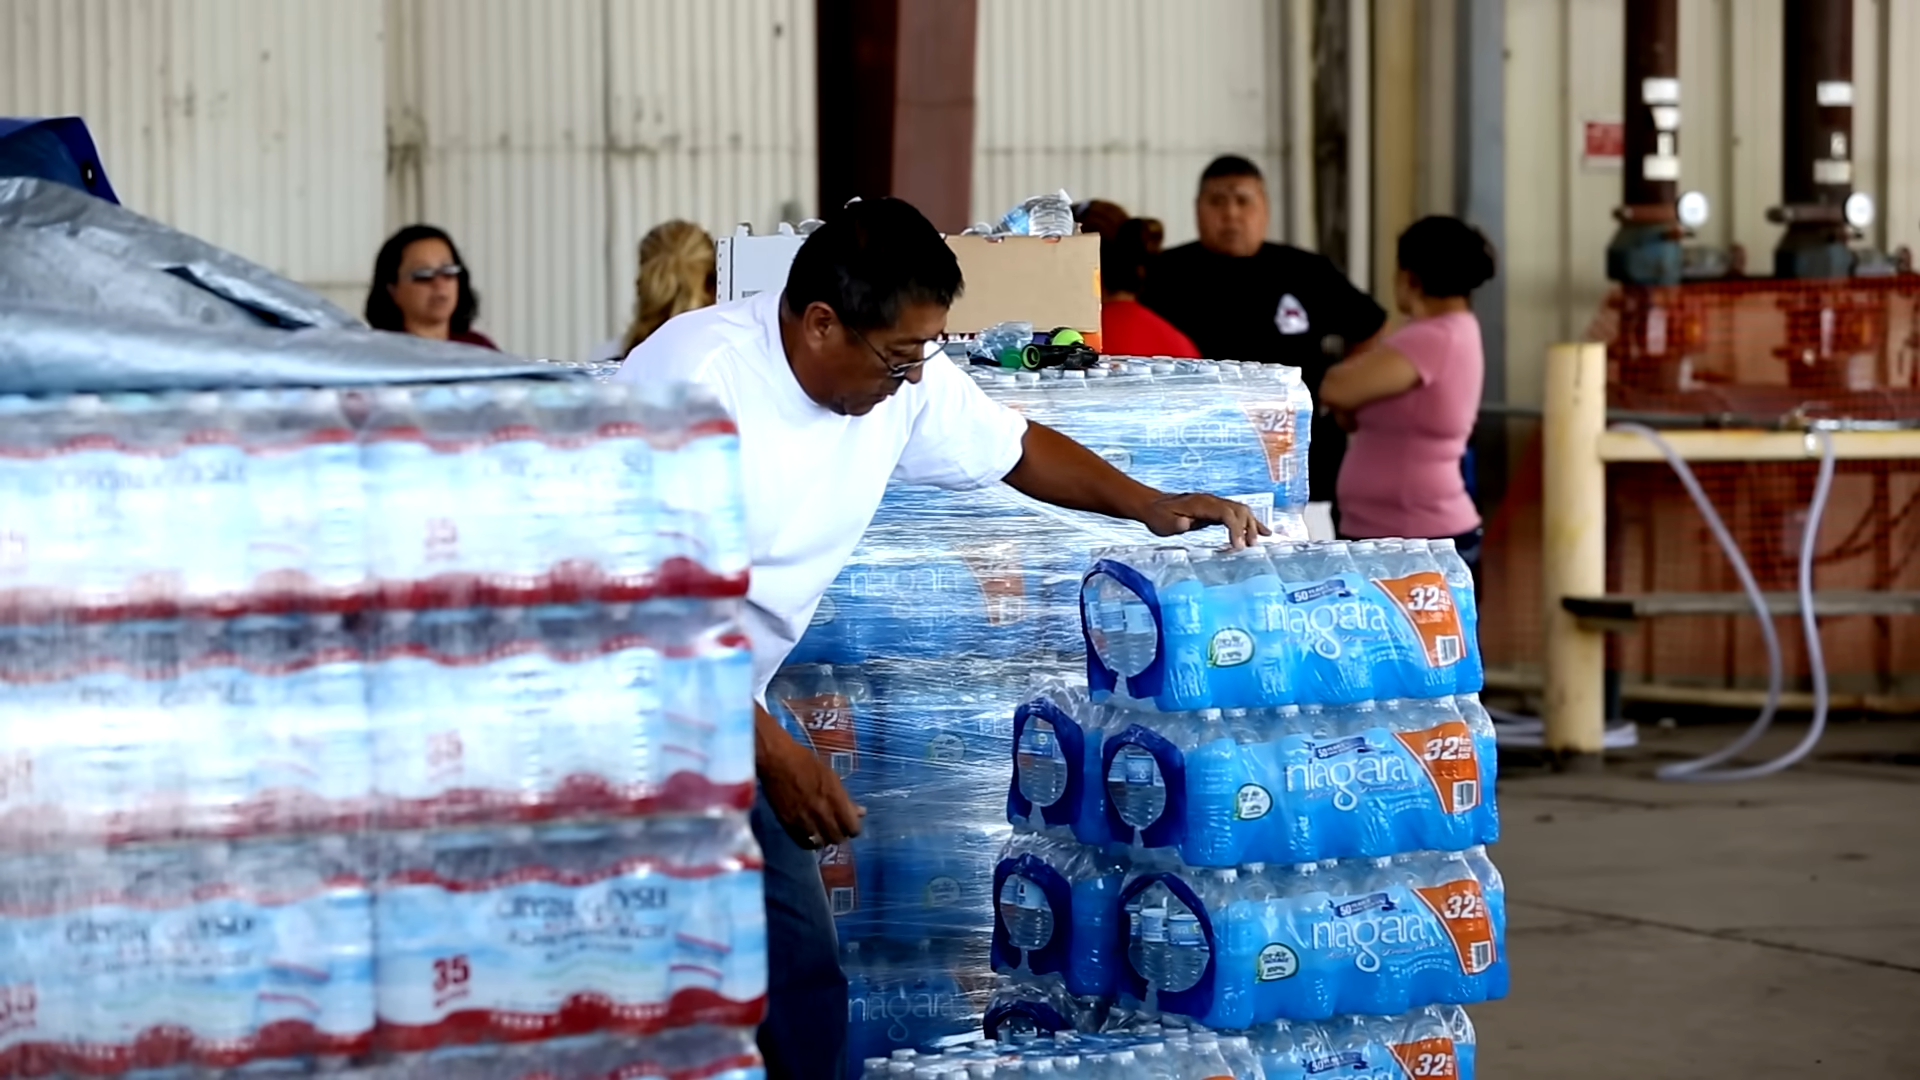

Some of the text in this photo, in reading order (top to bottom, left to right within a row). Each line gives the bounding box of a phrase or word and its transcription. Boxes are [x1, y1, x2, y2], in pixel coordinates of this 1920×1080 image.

[1259, 410, 1287, 432] 32
[1294, 591, 1308, 602] 50
[1408, 587, 1440, 610] 32
[1266, 601, 1388, 659] niagara
[808, 708, 838, 730] 32
[1424, 736, 1458, 761] 32
[1286, 755, 1408, 811] niagara
[817, 845, 841, 864] 2
[1340, 904, 1351, 916] 50
[1444, 895, 1475, 919] 32
[1314, 913, 1427, 972] niagara
[432, 955, 469, 991] 35
[1415, 1053, 1446, 1076] 32
